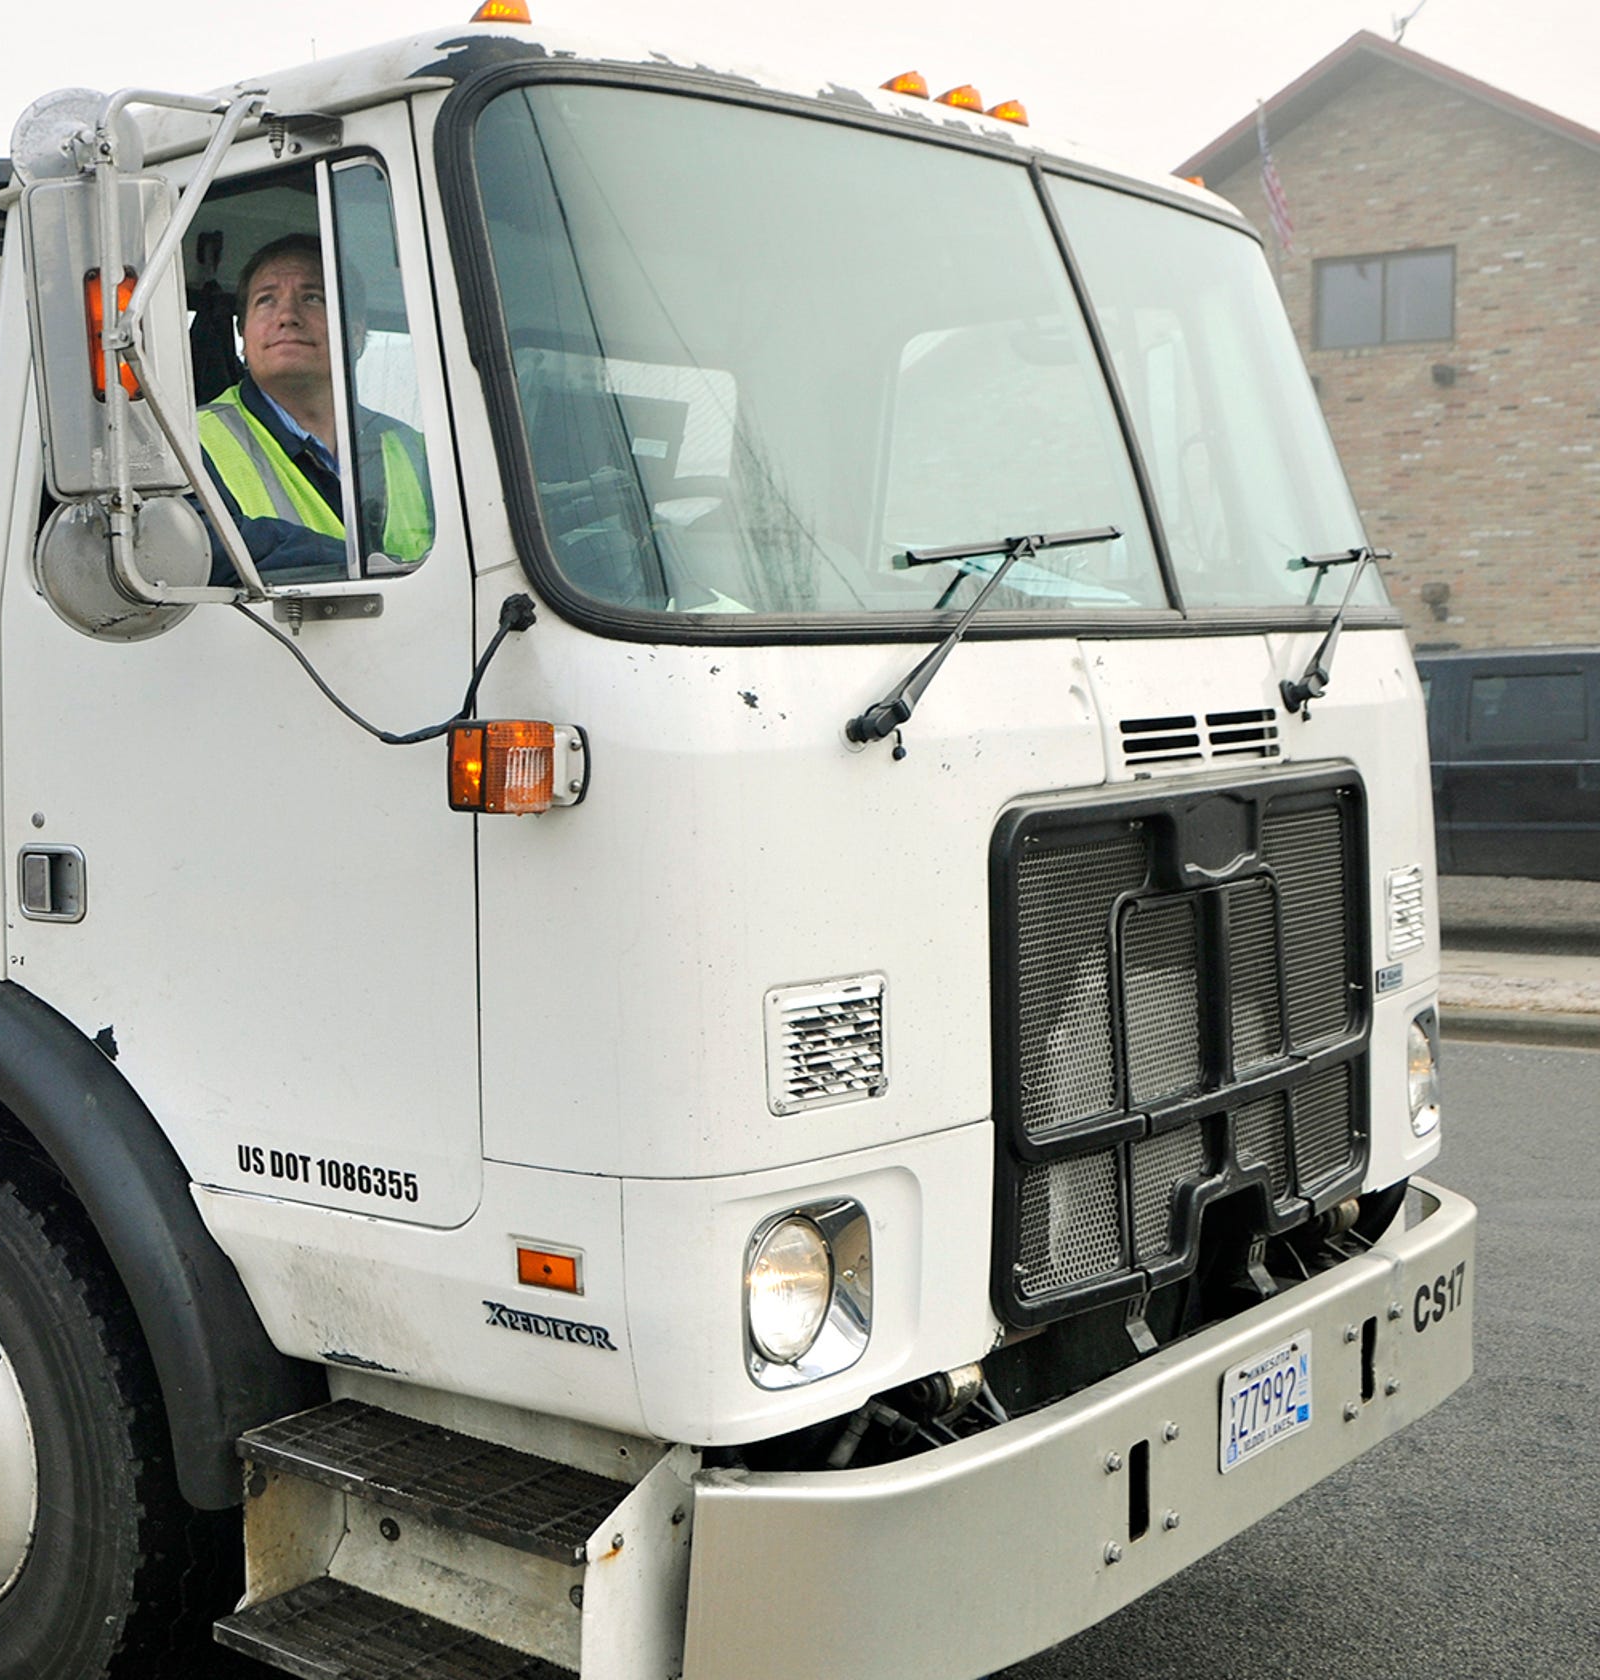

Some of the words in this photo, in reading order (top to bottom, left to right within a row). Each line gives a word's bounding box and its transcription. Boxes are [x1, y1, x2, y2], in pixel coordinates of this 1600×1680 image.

[237, 1144, 265, 1175] US
[270, 1150, 311, 1184] DOT
[315, 1158, 419, 1203] 1086355
[1414, 1261, 1465, 1333] CS17
[1238, 1366, 1297, 1440] Z7992
